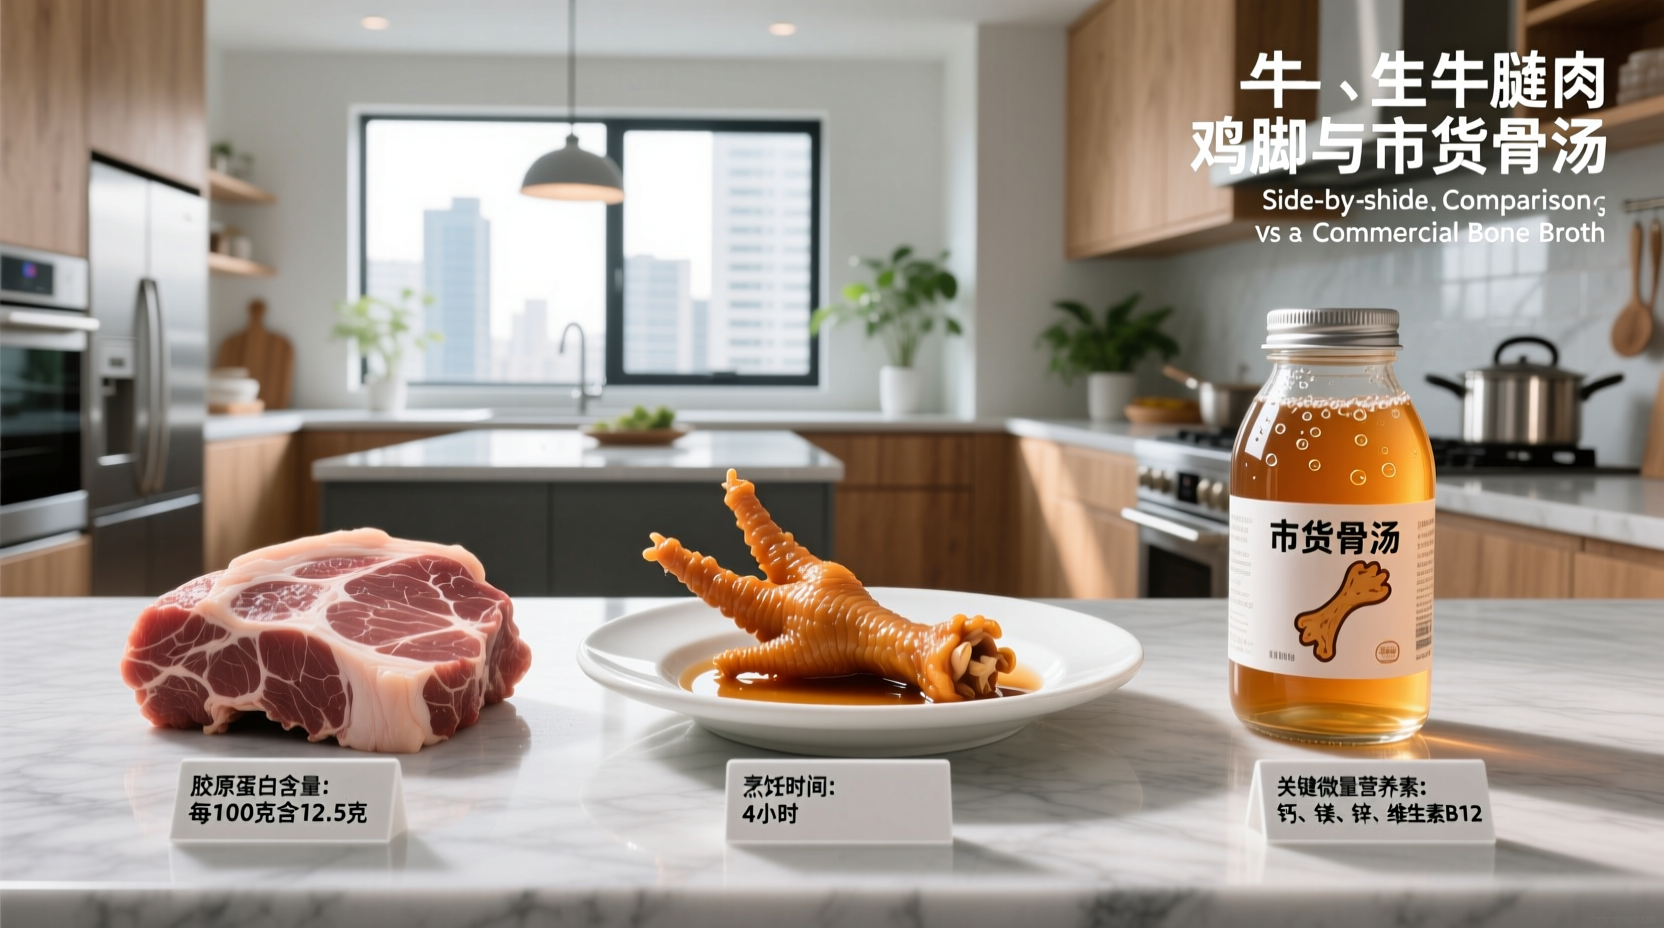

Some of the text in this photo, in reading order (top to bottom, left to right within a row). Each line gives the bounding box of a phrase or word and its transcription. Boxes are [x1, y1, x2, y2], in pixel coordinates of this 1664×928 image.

[1270, 518, 1401, 556] 市货骨汤
[188, 800, 368, 825] 每100克含12.5克
[742, 802, 799, 825] 4小时
